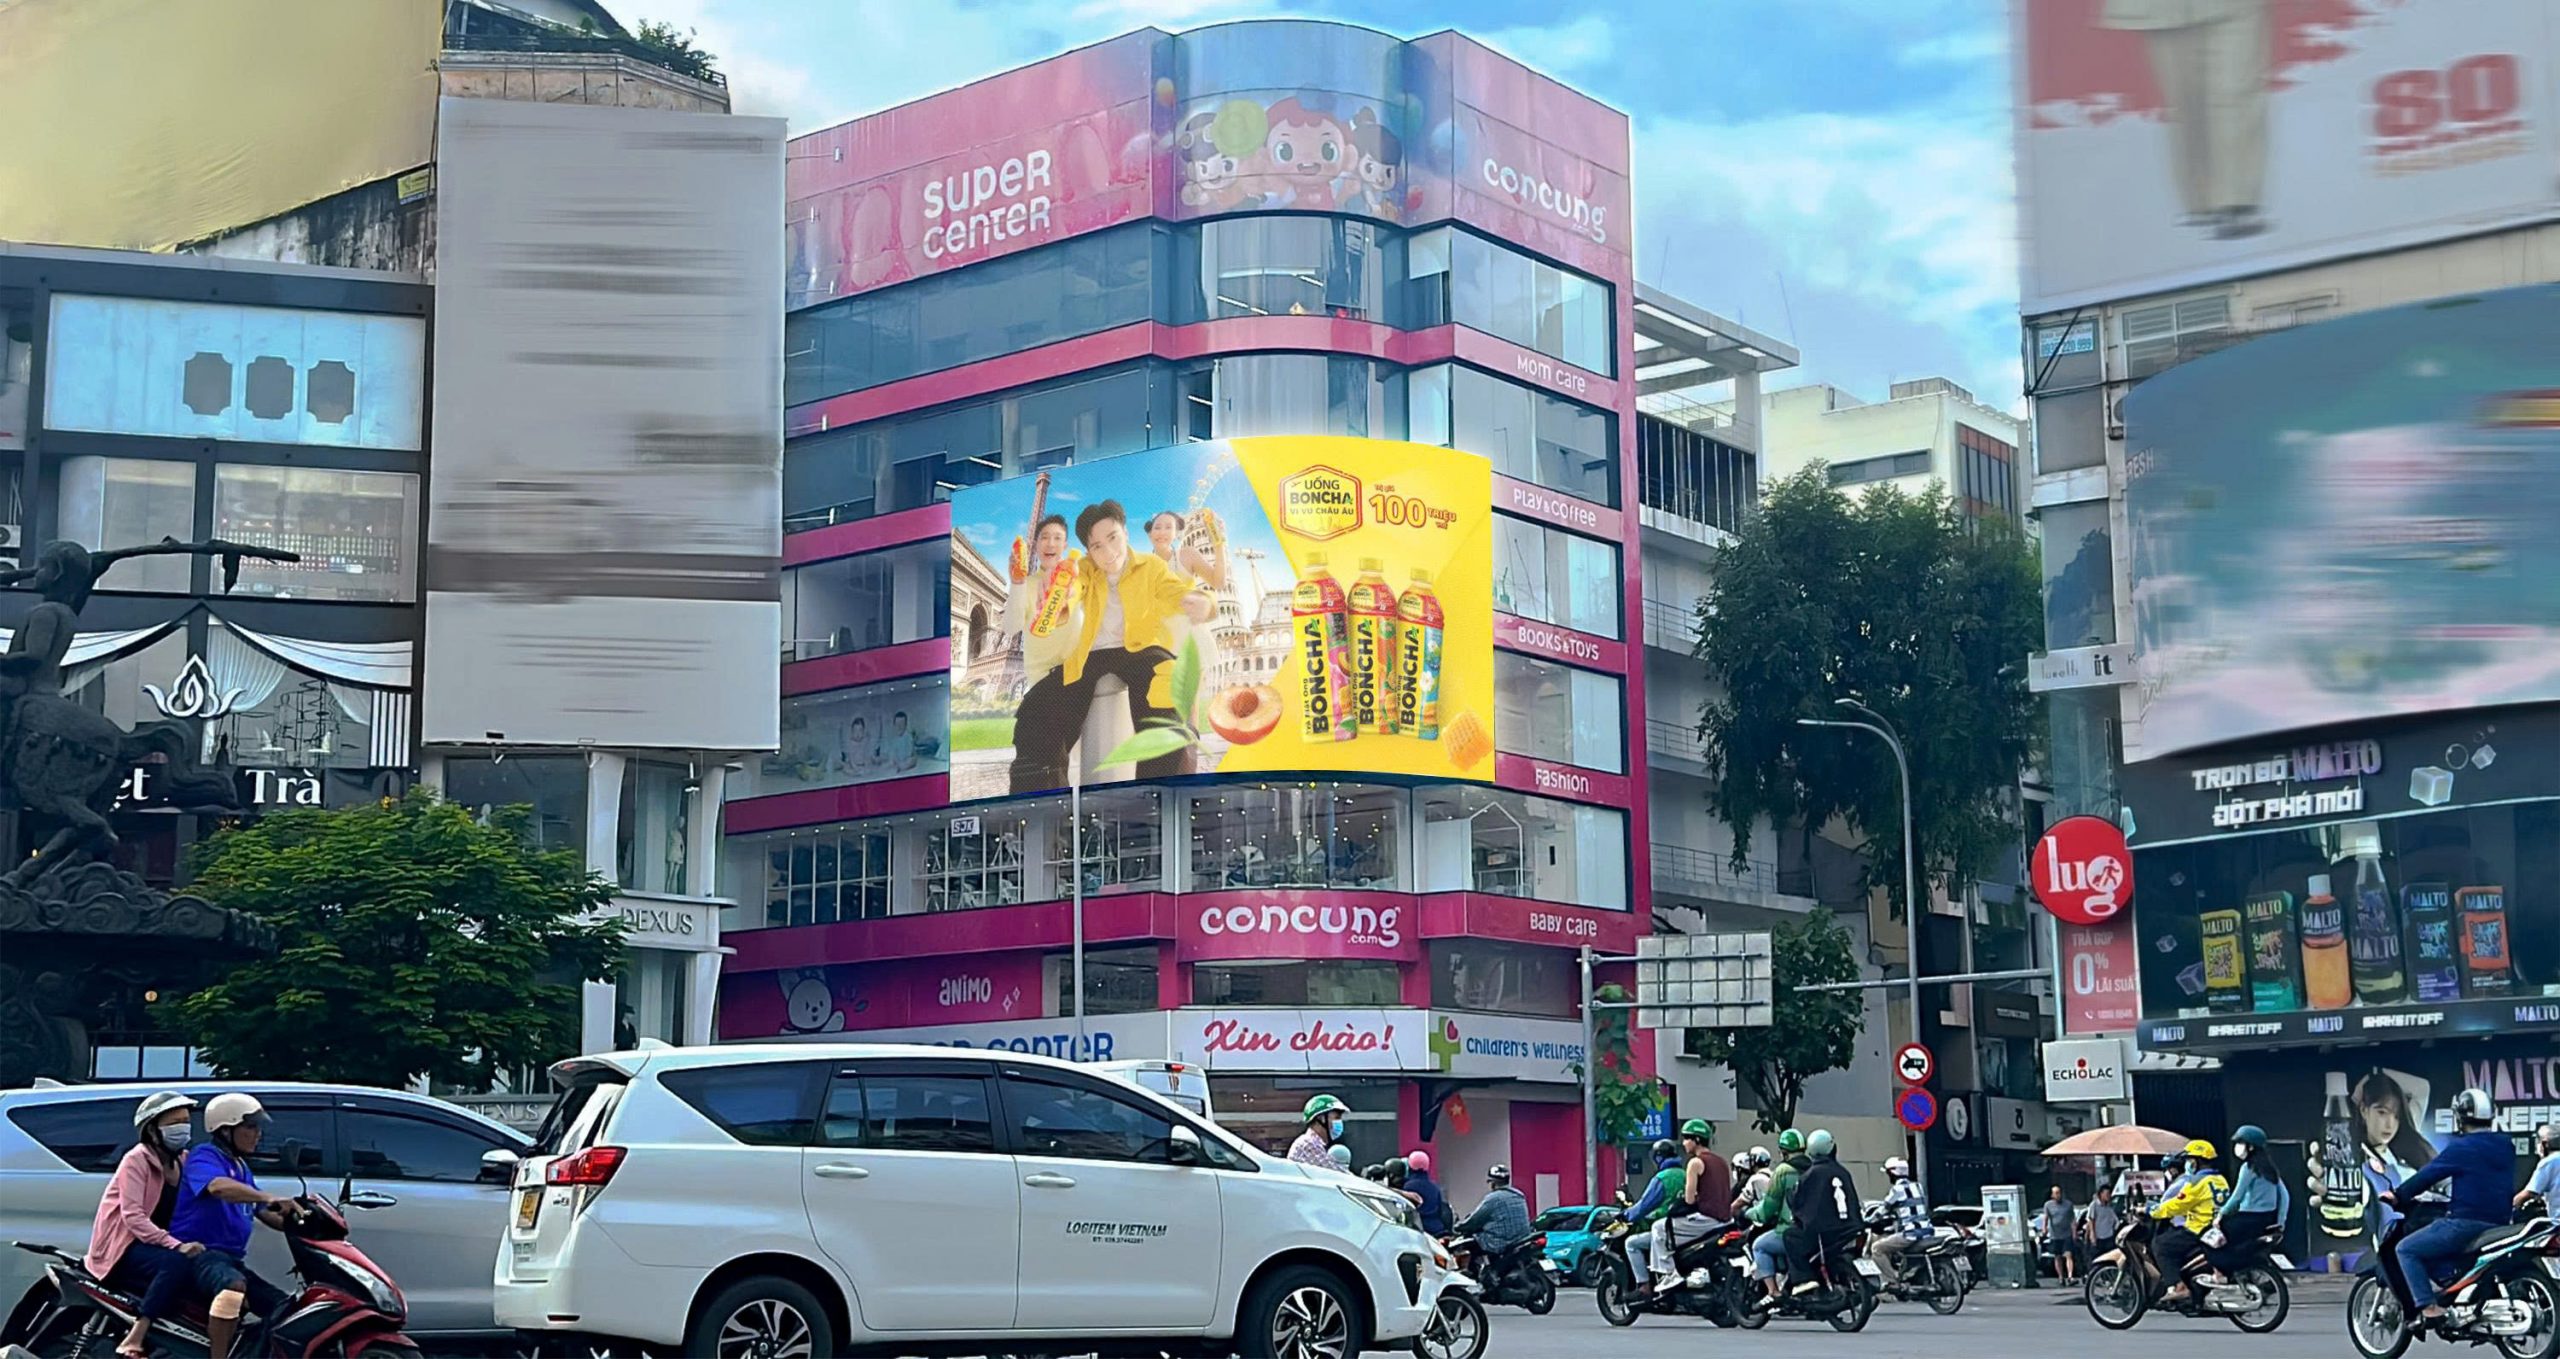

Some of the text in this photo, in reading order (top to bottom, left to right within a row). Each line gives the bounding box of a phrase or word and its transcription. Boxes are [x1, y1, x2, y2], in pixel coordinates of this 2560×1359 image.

[1290, 491, 1354, 505] BONCHA
[1368, 494, 1427, 529] 100
[1304, 618, 1330, 734] BONCHA
[1357, 618, 1375, 725] BONCHA
[1400, 626, 1420, 726] BONCHA
[2292, 740, 2382, 783] MALTO
[245, 768, 322, 805] Trà
[2246, 899, 2283, 919] MALTO
[2409, 891, 2449, 908] MALTO
[2465, 894, 2503, 910] MALTO
[1200, 905, 1401, 948] concung
[2202, 918, 2233, 934] MALTO
[2302, 908, 2341, 929] MALTO
[2307, 1016, 2344, 1033] MALTO
[2514, 1005, 2560, 1022] MALTO
[1203, 1019, 1394, 1053] Xin chào!
[1466, 1037, 1529, 1058] Children's
[2052, 1066, 2113, 1081] ECHOLAC
[1065, 1221, 1168, 1237] LOGITEM VIETNAM
